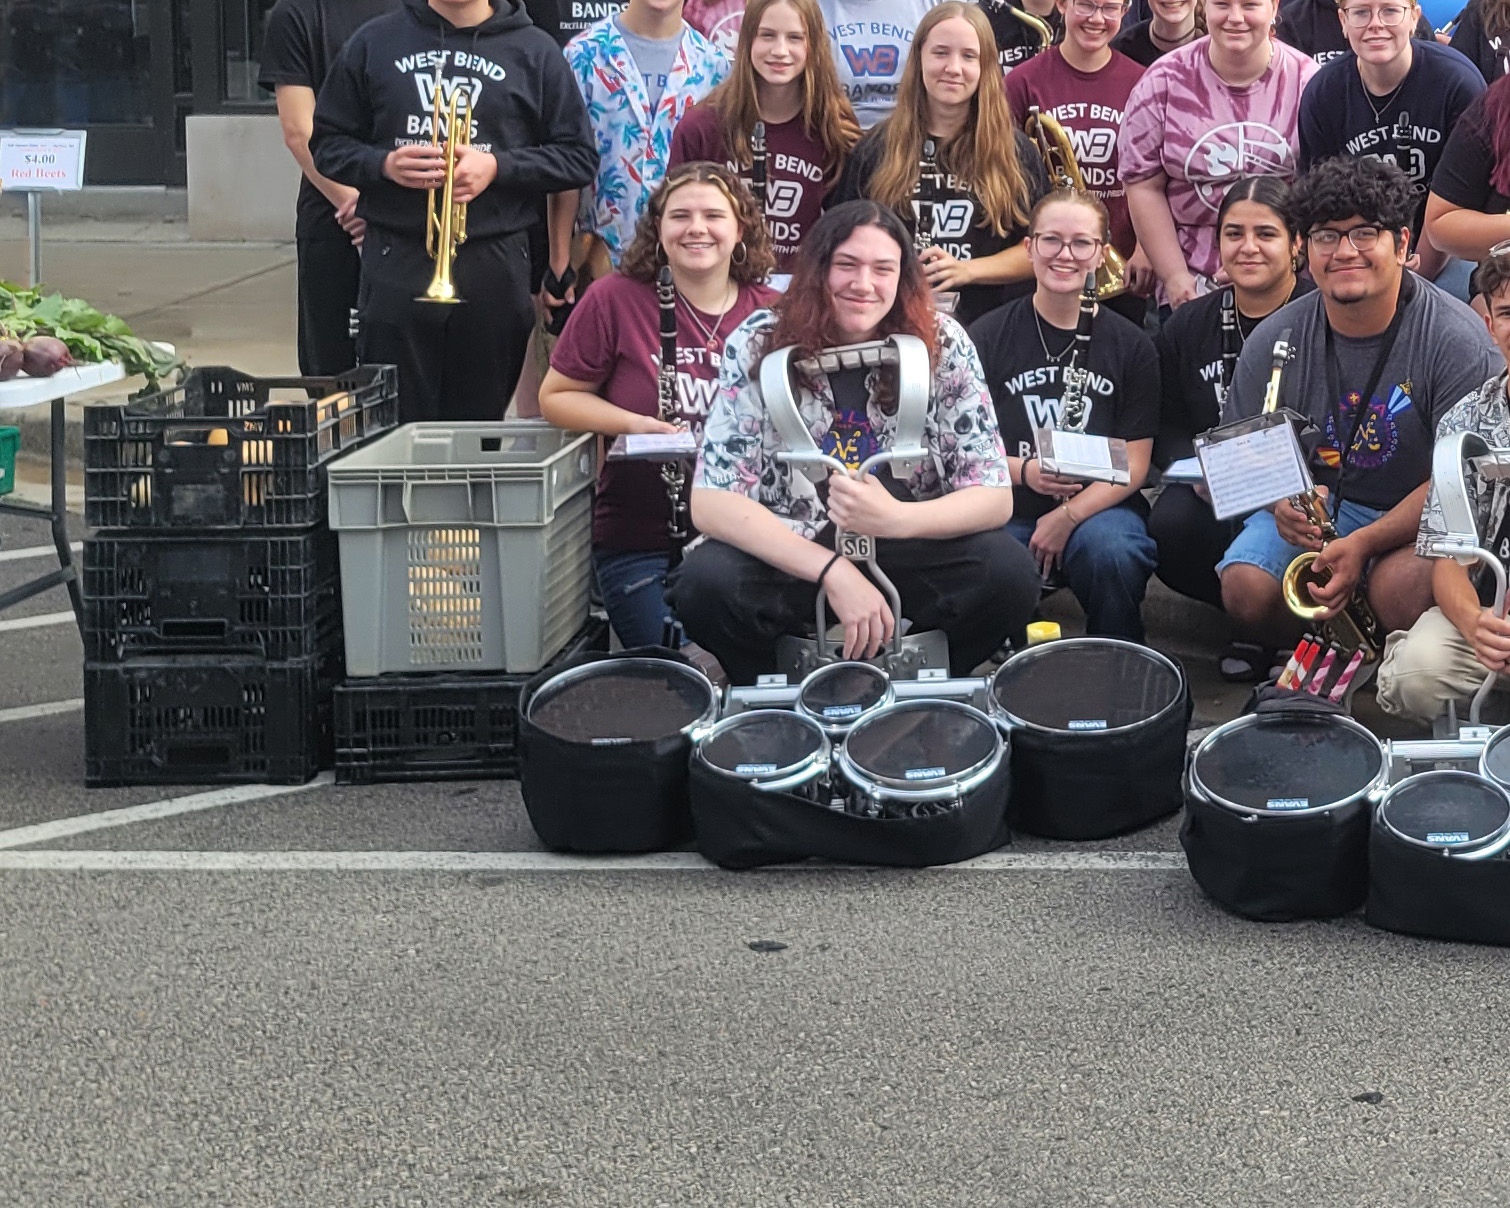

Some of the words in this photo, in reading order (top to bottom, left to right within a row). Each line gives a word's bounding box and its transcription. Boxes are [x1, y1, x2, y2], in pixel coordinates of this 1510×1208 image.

[394, 50, 451, 73] WEST
[454, 50, 506, 81] BEND
[1090, 104, 1125, 124] BEN
[1346, 126, 1389, 155] WEST
[24, 154, 56, 164] $4.00
[11, 169, 32, 178] Red
[775, 153, 823, 182] BEND
[1004, 366, 1059, 395] WEST
[1068, 721, 1107, 729] EVANS
[1267, 800, 1308, 809] EVANS
[1427, 834, 1469, 842] EVANS
